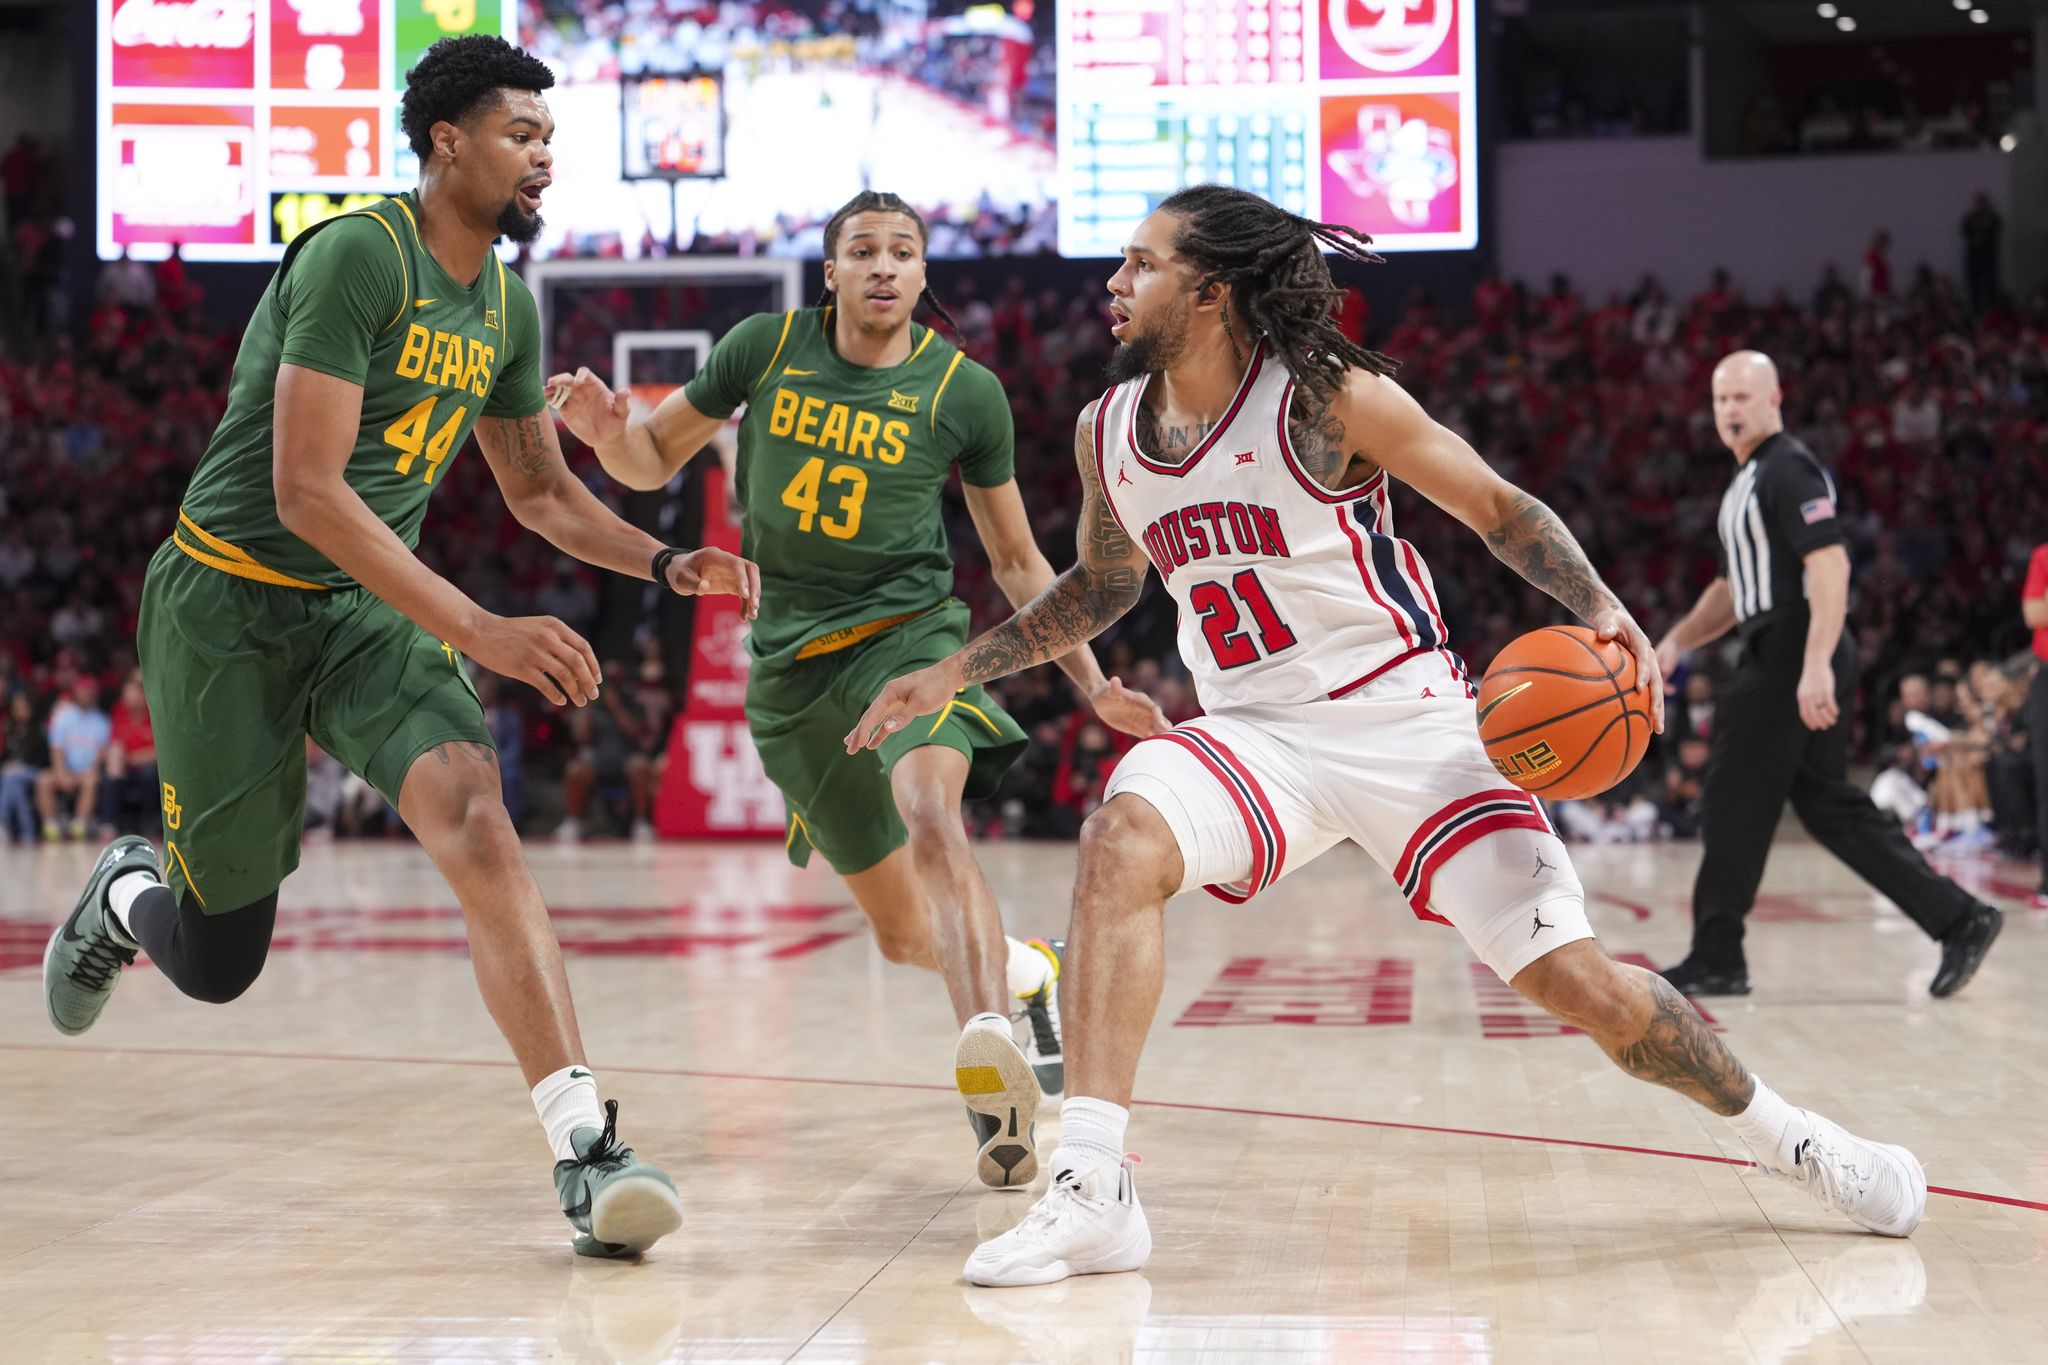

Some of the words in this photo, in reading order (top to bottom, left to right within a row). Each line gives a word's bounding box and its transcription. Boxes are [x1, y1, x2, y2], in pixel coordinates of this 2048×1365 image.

[395, 322, 495, 398] BEARS
[383, 395, 468, 485] 44
[768, 387, 910, 464] BEARS
[780, 456, 869, 540] 43
[1189, 567, 1298, 671] 21
